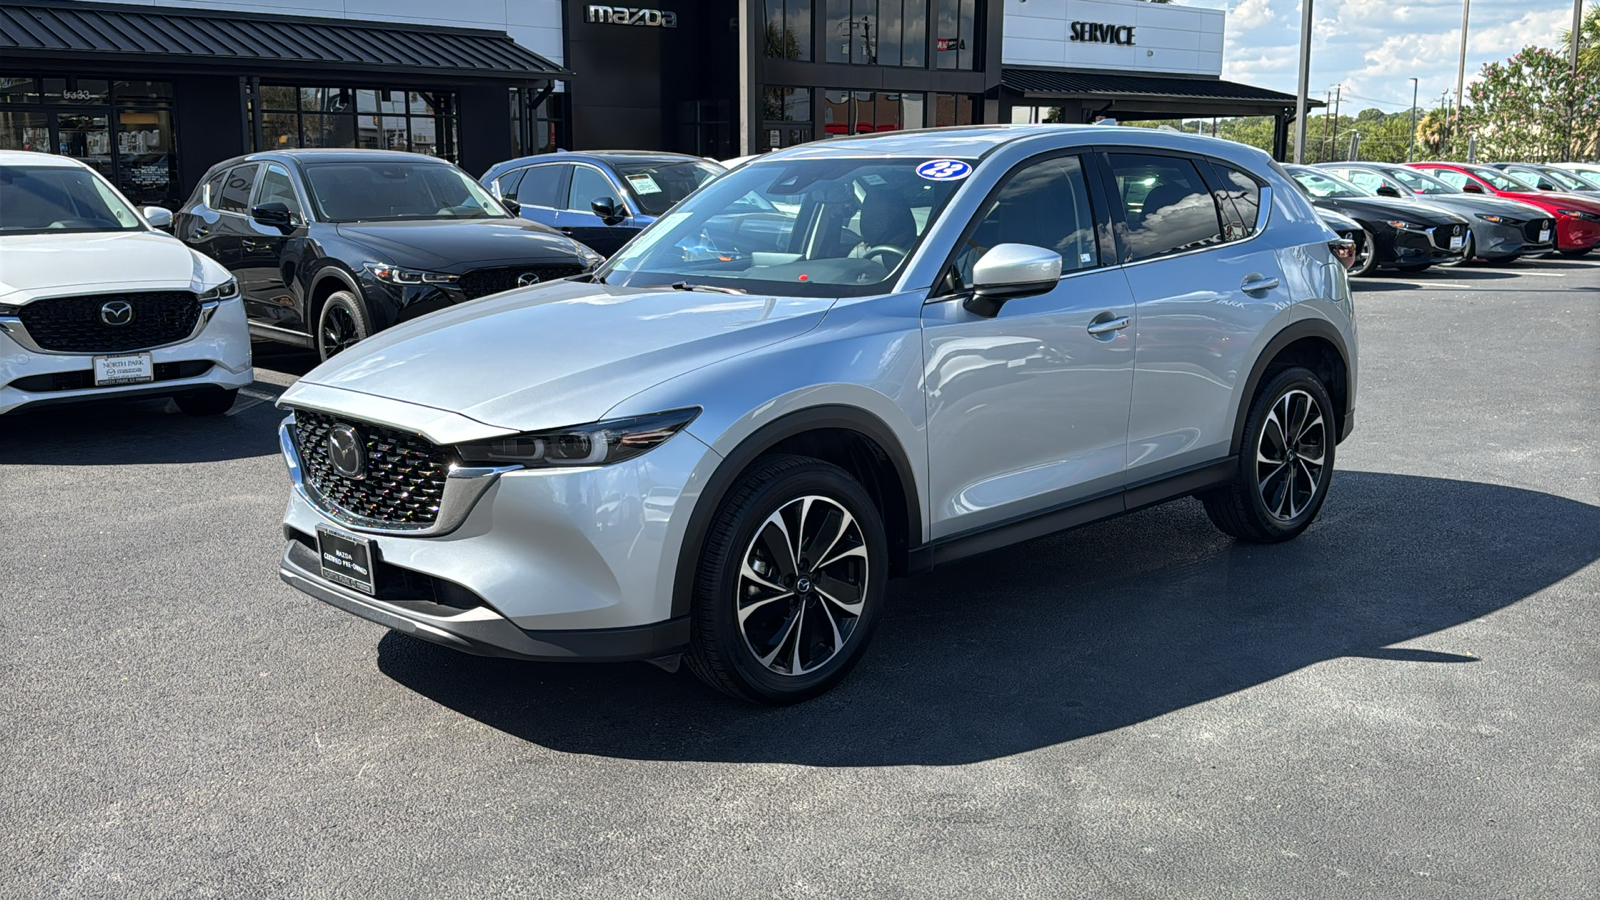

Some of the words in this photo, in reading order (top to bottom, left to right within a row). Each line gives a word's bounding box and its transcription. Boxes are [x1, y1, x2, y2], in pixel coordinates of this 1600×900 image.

[1070, 21, 1136, 46] SERVICE
[921, 161, 964, 178] 23
[102, 361, 127, 369] NORTH
[323, 552, 342, 565] CERTIFIED
[343, 560, 367, 575] PRE-OWNED
[335, 549, 353, 561] MAZDA
